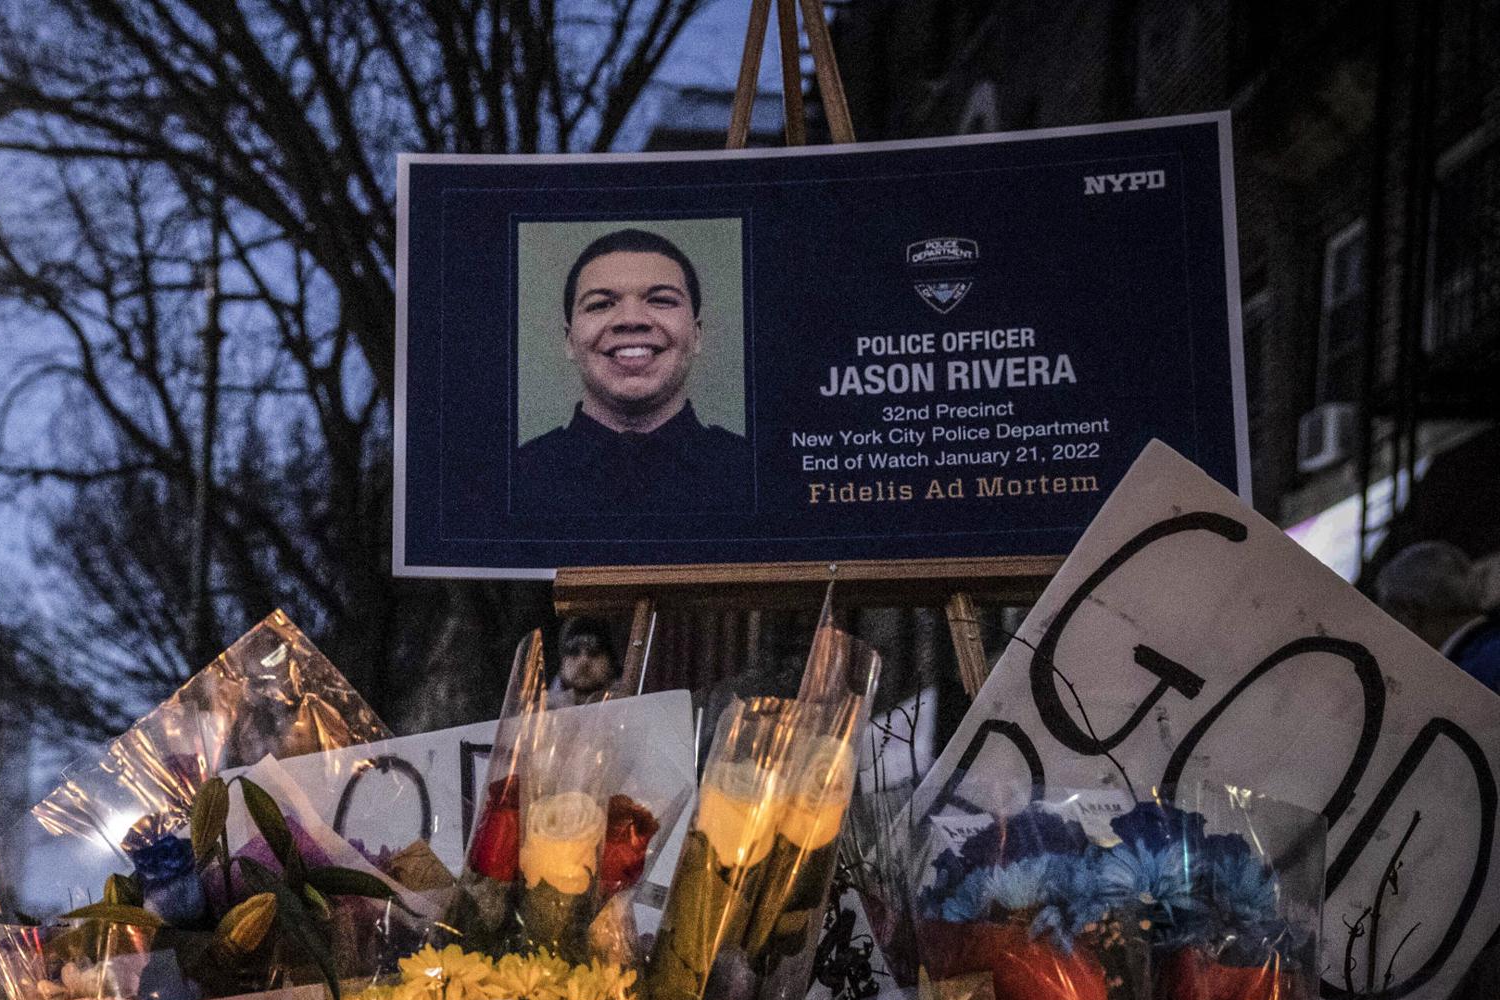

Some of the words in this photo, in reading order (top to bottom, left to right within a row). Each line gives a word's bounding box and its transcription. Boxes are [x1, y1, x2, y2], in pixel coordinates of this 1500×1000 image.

[1084, 170, 1165, 195] NYPD
[857, 333, 935, 356] POLICE
[943, 328, 1035, 352] OFFICER
[820, 362, 934, 397] JASON
[948, 354, 1076, 391] RIVERA
[882, 405, 929, 422] 32nd
[937, 401, 1014, 419] Precinct
[792, 431, 833, 447] New
[839, 430, 882, 446] York
[889, 427, 925, 447] City
[932, 424, 989, 442] Police
[996, 418, 1110, 443] Department
[802, 455, 838, 471] End
[845, 454, 864, 469] of
[868, 451, 929, 468] Watch
[934, 448, 1010, 468] January
[1016, 447, 1046, 464] 21,
[1052, 442, 1100, 460] 2022
[809, 481, 913, 503] Fidelis
[925, 478, 964, 499] Ad
[976, 473, 1099, 498] Mortem
